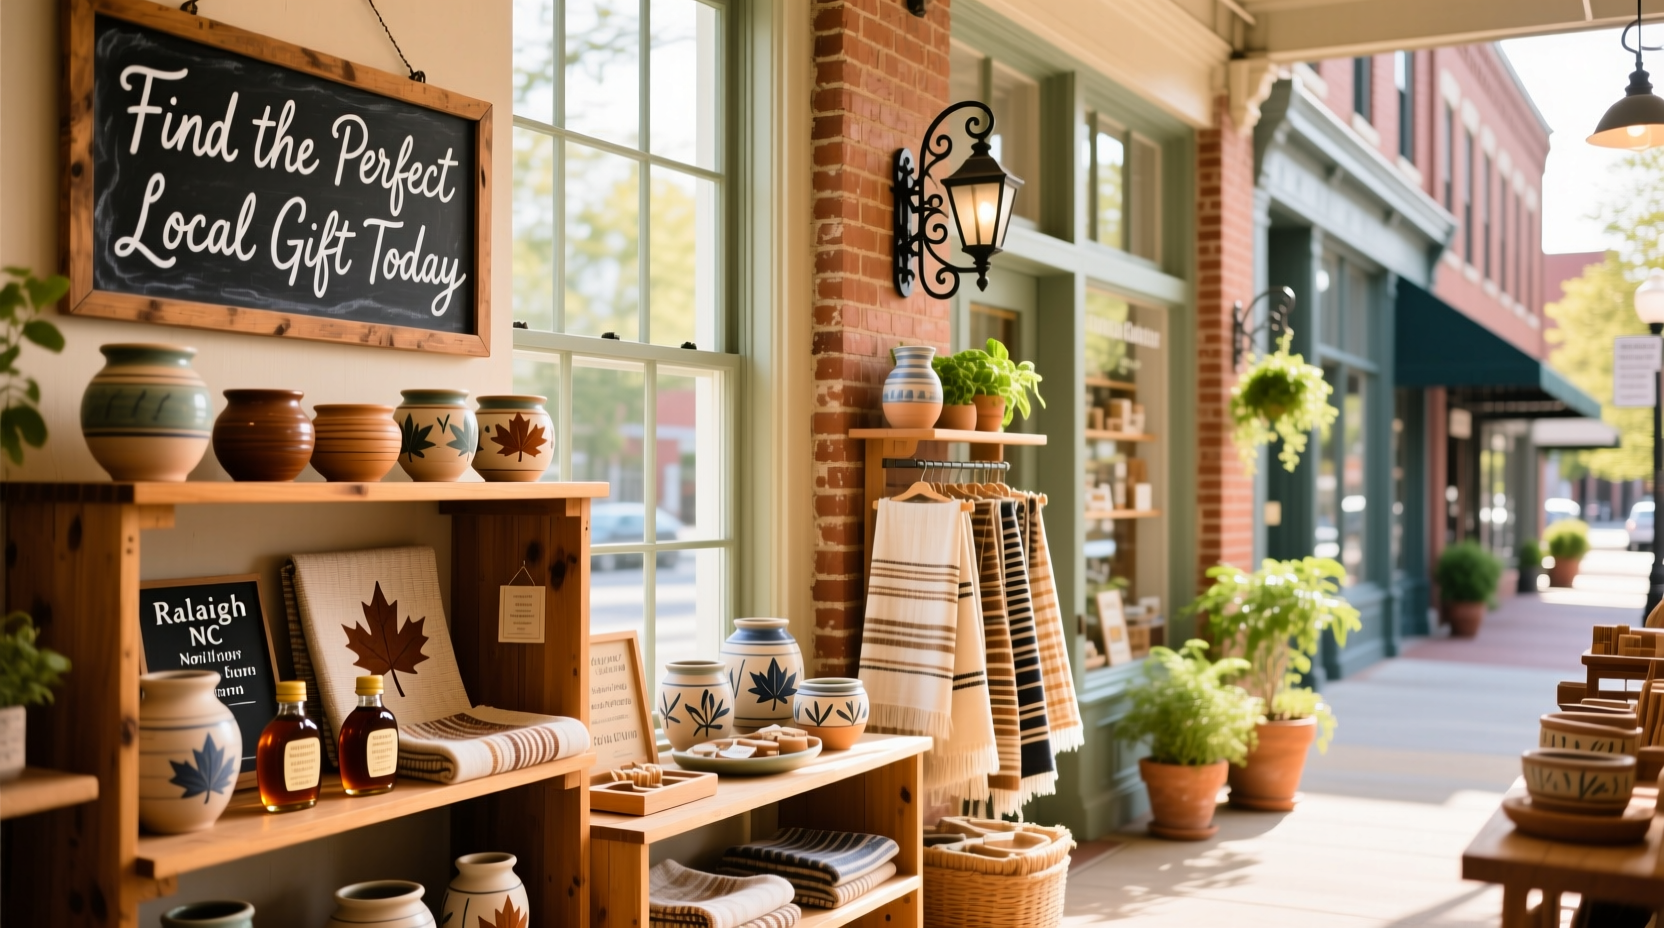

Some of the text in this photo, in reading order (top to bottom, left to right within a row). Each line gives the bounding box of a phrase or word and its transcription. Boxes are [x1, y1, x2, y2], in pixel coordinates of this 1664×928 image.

[119, 64, 459, 217] Find the Perfect
[114, 172, 467, 317] Local Gift Today
[152, 593, 247, 626] Ralaigh
[188, 624, 223, 647] NC
